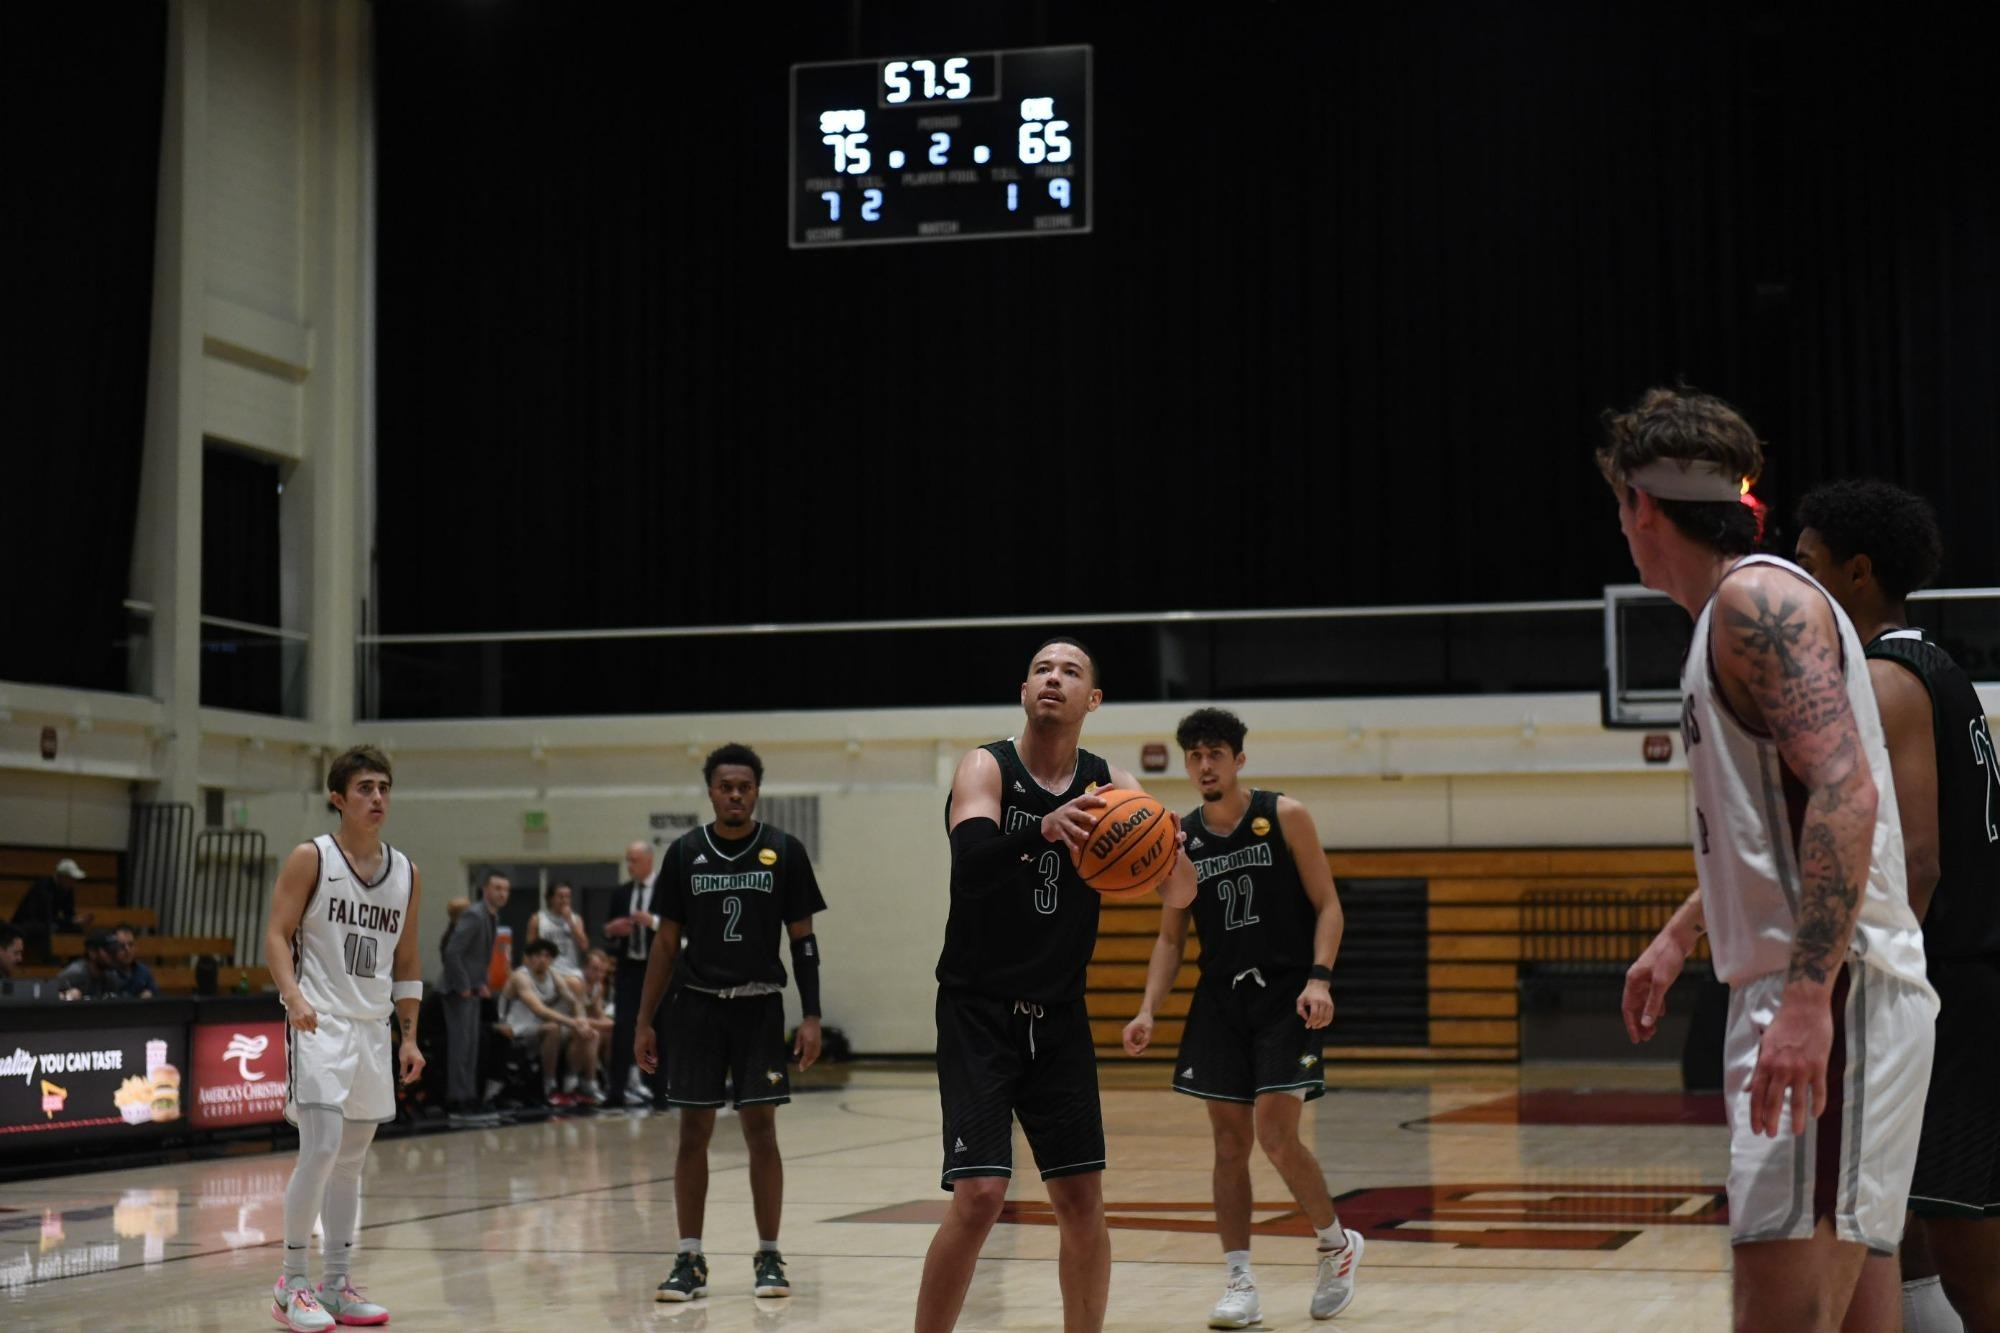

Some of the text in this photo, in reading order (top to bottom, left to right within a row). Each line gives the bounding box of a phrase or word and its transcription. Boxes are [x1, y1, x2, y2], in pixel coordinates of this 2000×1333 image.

[884, 57, 971, 103] 57.5
[822, 133, 871, 174] 75
[928, 132, 951, 165] 2
[1019, 120, 1072, 164] 65
[821, 191, 841, 222] 7
[861, 188, 883, 221] 2
[1007, 183, 1018, 211] 1
[1048, 177, 1071, 208] 9
[1089, 808, 1153, 860] Wilson
[1034, 850, 1060, 914] 3
[1192, 842, 1272, 884] CONCORDIA
[691, 871, 774, 896] CONCORDIA
[1217, 874, 1260, 930] 22
[328, 897, 401, 934] FALCONS
[723, 896, 742, 942] 2
[344, 932, 378, 978] 10
[39, 1053, 65, 1074] YOU
[66, 1052, 91, 1072] CAN
[91, 1049, 123, 1070] TASTE
[203, 1098, 283, 1117] CREDIT UNION
